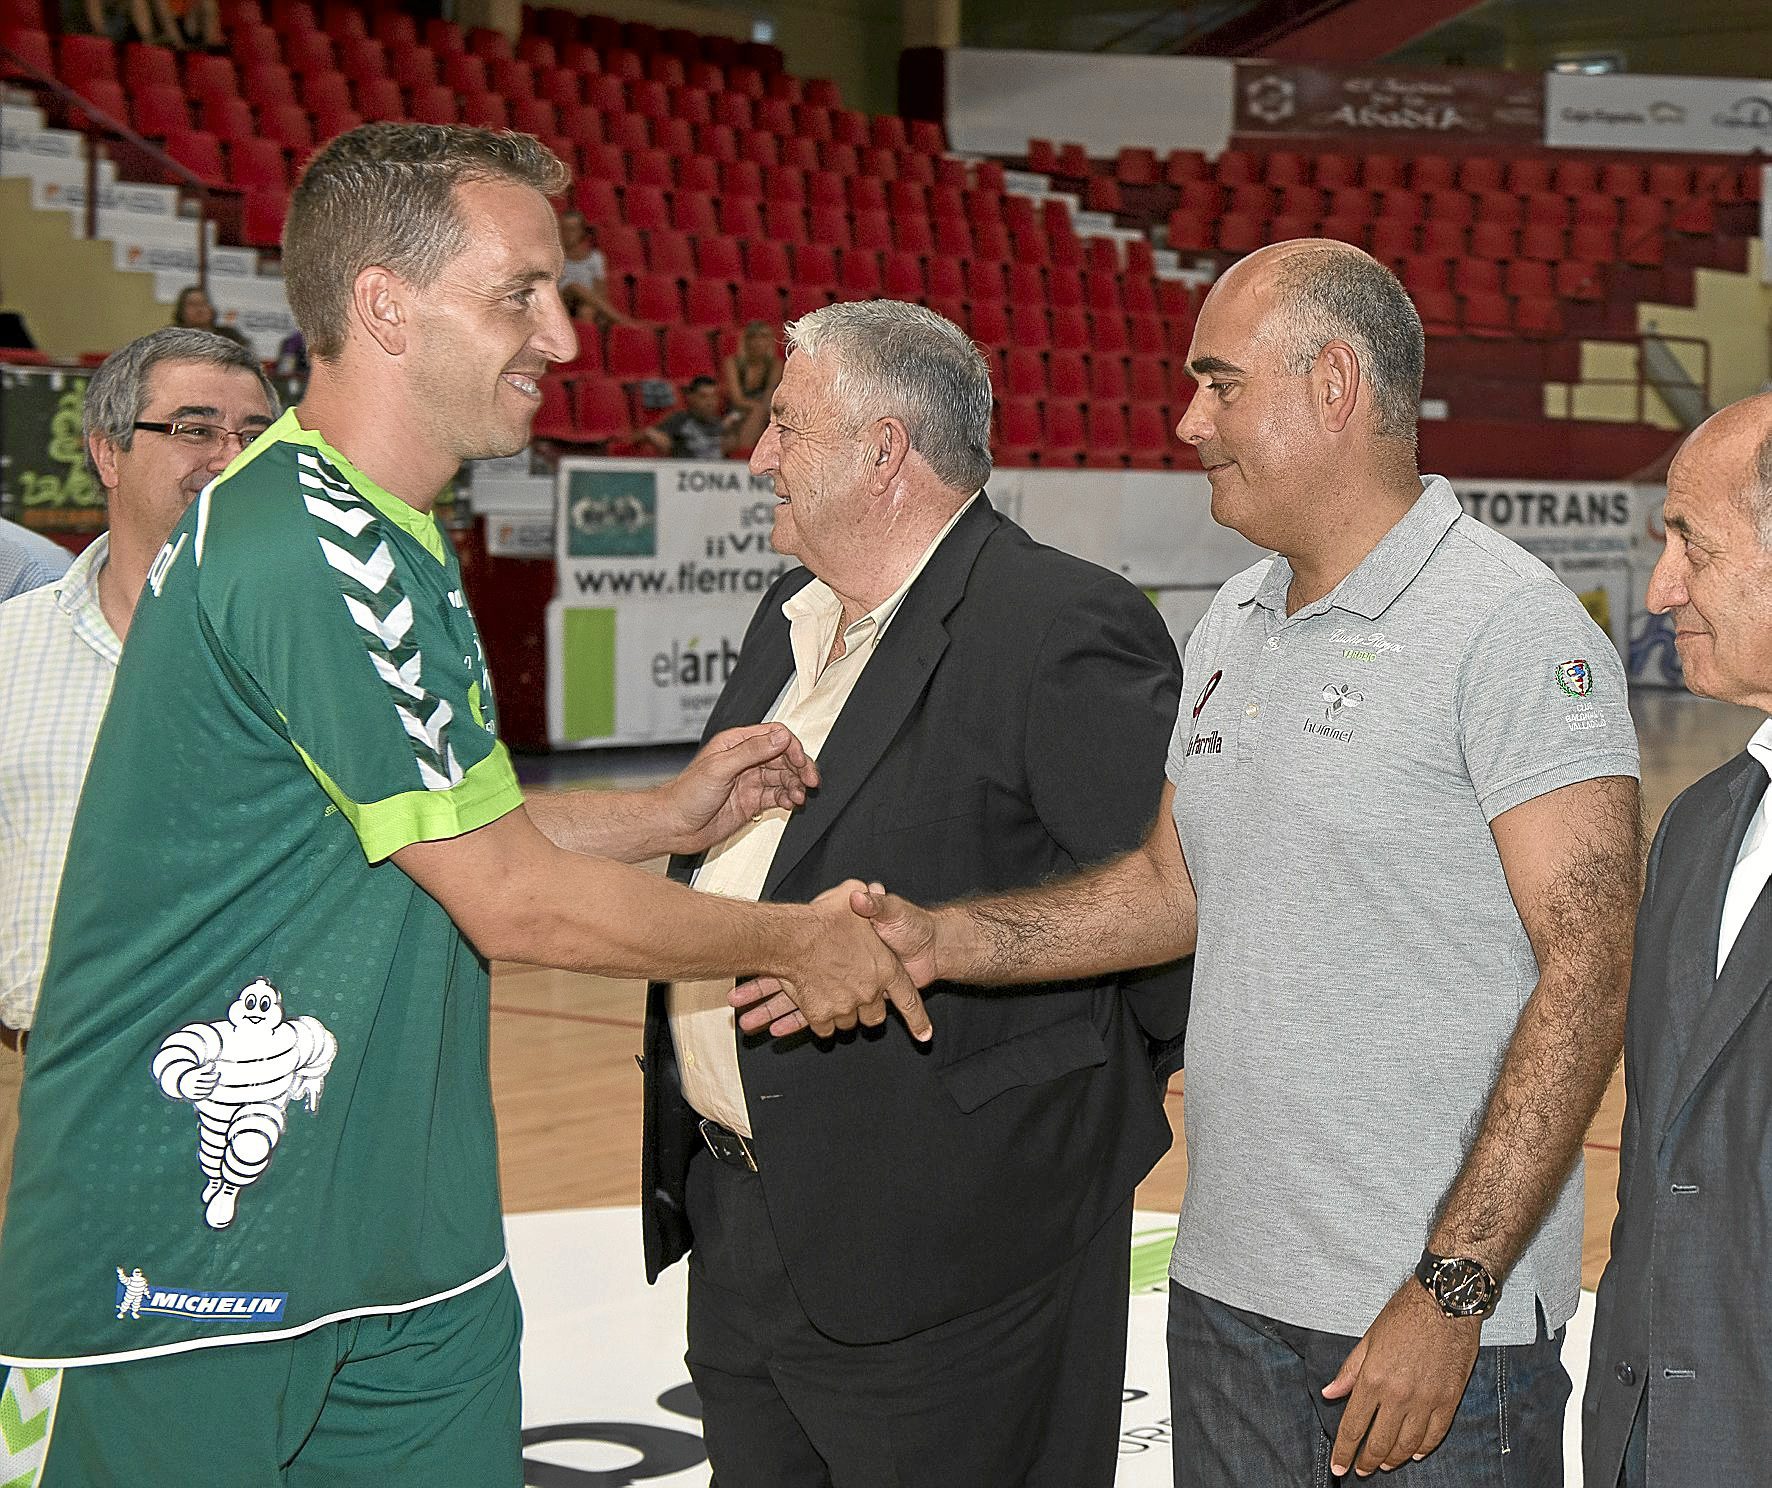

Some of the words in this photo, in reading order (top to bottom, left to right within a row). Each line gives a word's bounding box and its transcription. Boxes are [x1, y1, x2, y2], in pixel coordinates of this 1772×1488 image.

[677, 470, 740, 493] ZONA
[1457, 491, 1630, 527] TOTRANS
[1303, 717, 1353, 743] hummel
[150, 1292, 282, 1313] MICHELIN
